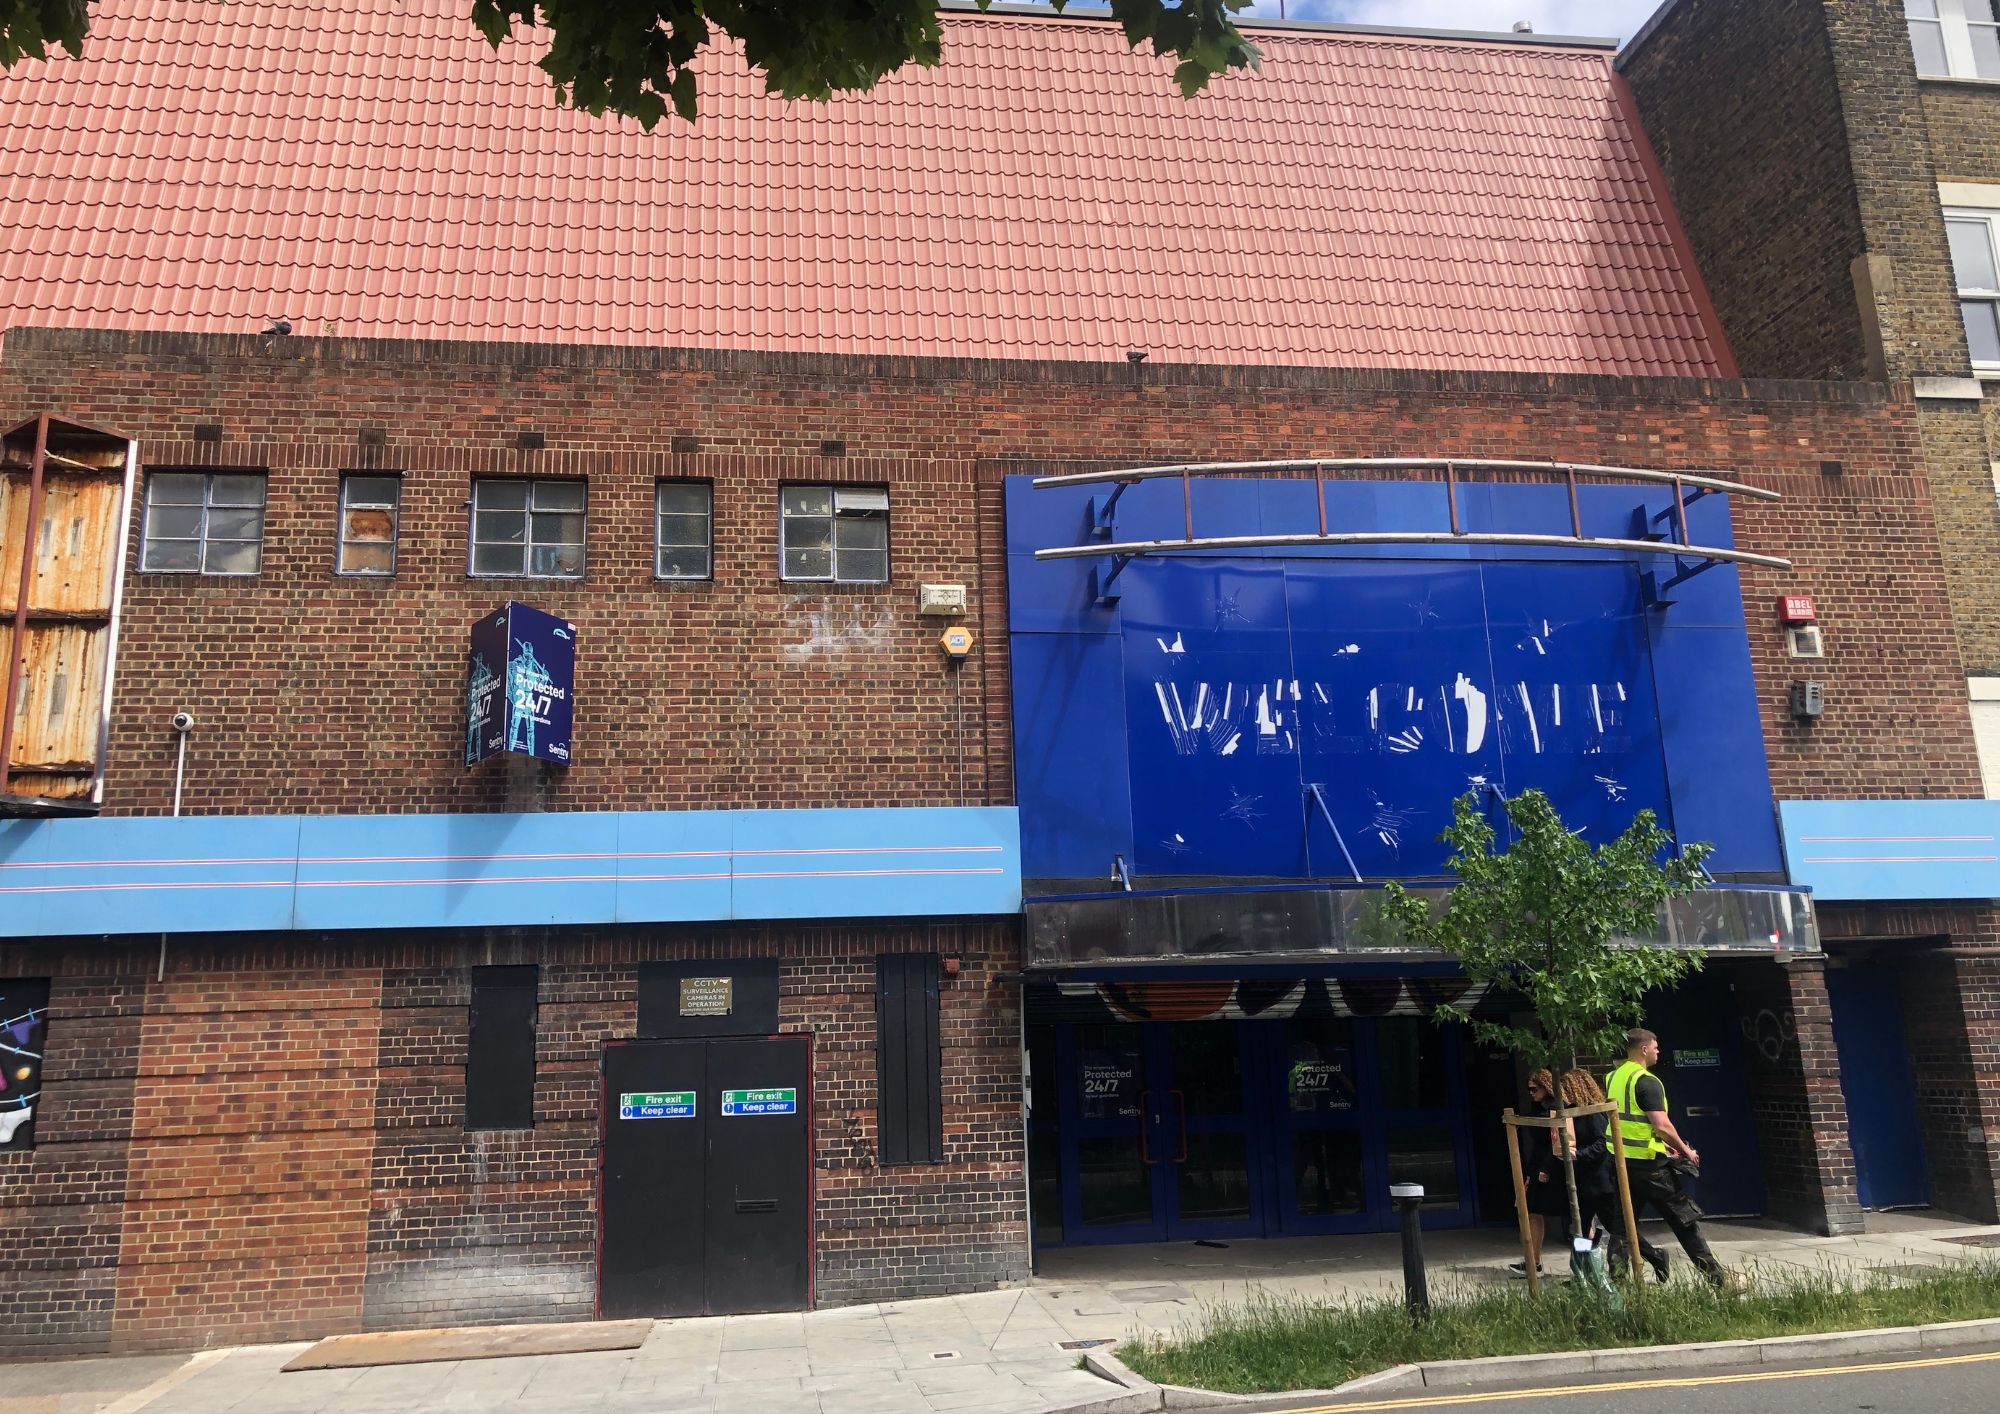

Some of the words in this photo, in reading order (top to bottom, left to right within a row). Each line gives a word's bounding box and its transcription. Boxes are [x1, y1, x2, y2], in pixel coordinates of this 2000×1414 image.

[1788, 599, 1811, 608] ABEL
[471, 674, 501, 701] Protected
[515, 673, 565, 700] Protected
[470, 694, 492, 722] 24/7
[515, 689, 552, 716] 24/7
[489, 736, 502, 748] Sentry
[549, 743, 569, 760] Sentry
[694, 979, 719, 987] CCTV
[683, 987, 729, 995] SURVEILLANCE
[1084, 1068, 1132, 1079] Protected
[1295, 1063, 1342, 1074] Protected
[1296, 1073, 1329, 1087] 24/7
[1085, 1079, 1118, 1093] 24/7
[645, 1095, 663, 1104] Fire
[665, 1095, 682, 1104] exit
[746, 1092, 764, 1101] Fire
[766, 1092, 783, 1100] exit
[641, 1106, 663, 1116] Keep
[665, 1105, 687, 1115] clear
[742, 1103, 765, 1113] Keep
[766, 1103, 788, 1112] clear
[1329, 1101, 1352, 1109] Sentry
[1118, 1107, 1141, 1116] Sentry
